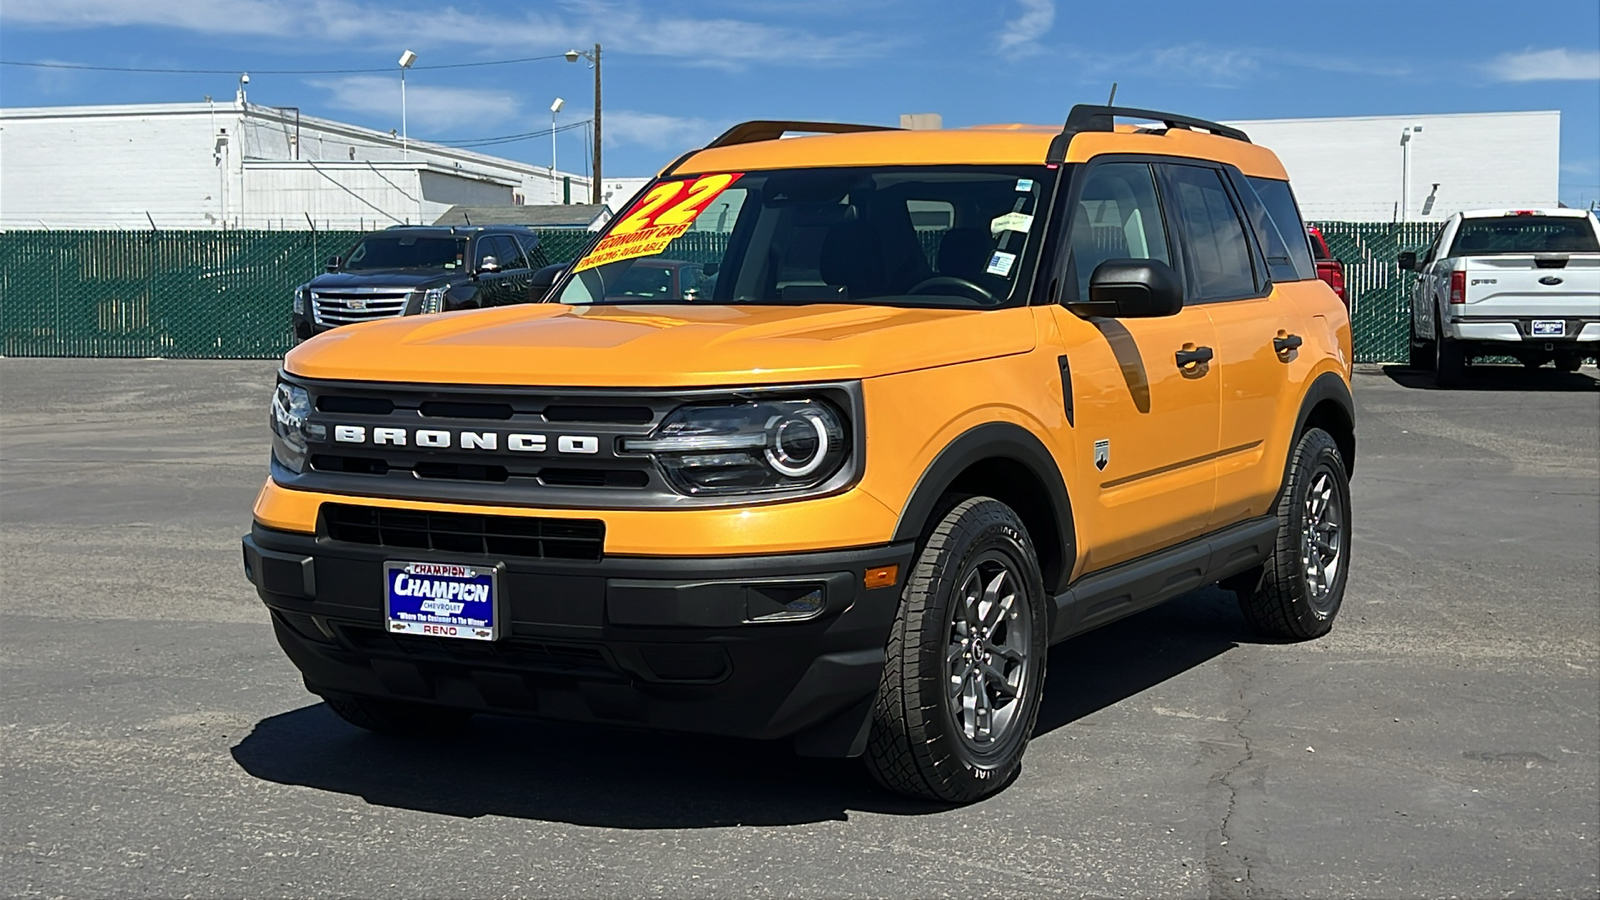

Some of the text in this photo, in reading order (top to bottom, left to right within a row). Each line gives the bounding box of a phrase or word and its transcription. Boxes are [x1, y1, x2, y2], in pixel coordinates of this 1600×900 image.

[609, 174, 733, 236] 22
[594, 223, 689, 252] ECONOMY CAR
[334, 425, 599, 454] BRONCO
[414, 564, 466, 577] CHAMPION
[394, 573, 489, 603] CHAMPION
[423, 601, 461, 612] CHEVROLET
[423, 625, 458, 636] RENO
